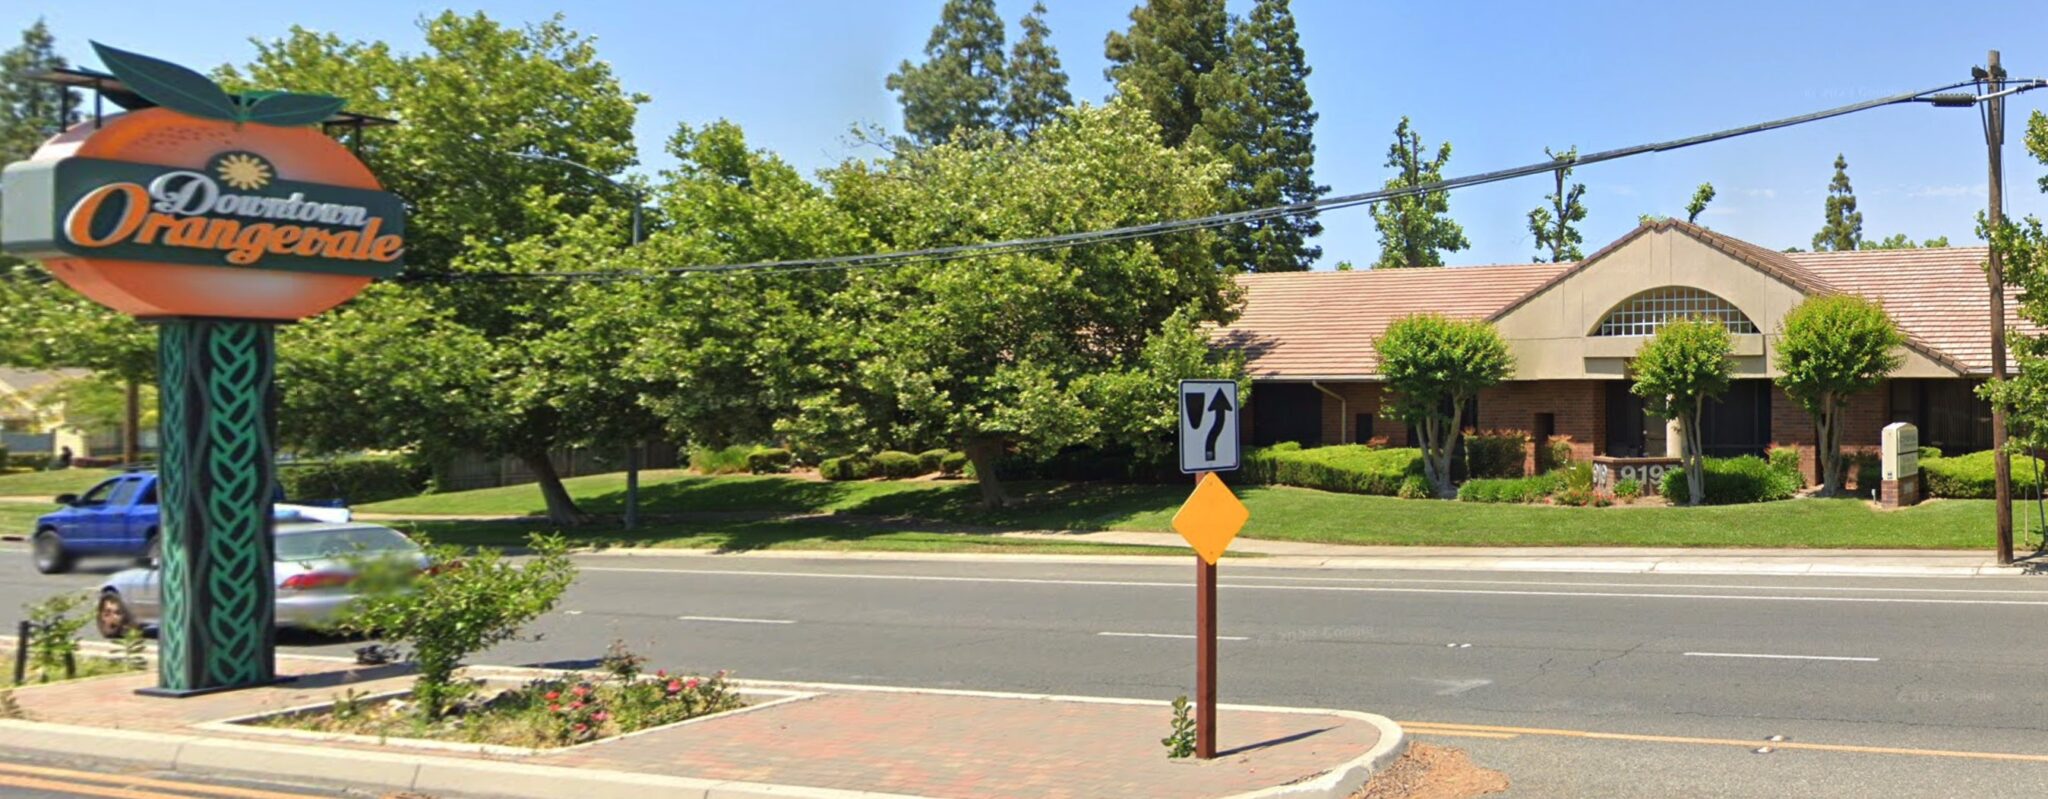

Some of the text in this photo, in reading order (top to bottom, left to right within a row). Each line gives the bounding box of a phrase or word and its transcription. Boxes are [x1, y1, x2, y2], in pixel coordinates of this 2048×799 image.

[64, 182, 404, 264] Orangevale
[149, 171, 367, 226] Downtown
[1621, 464, 1680, 485] 919
